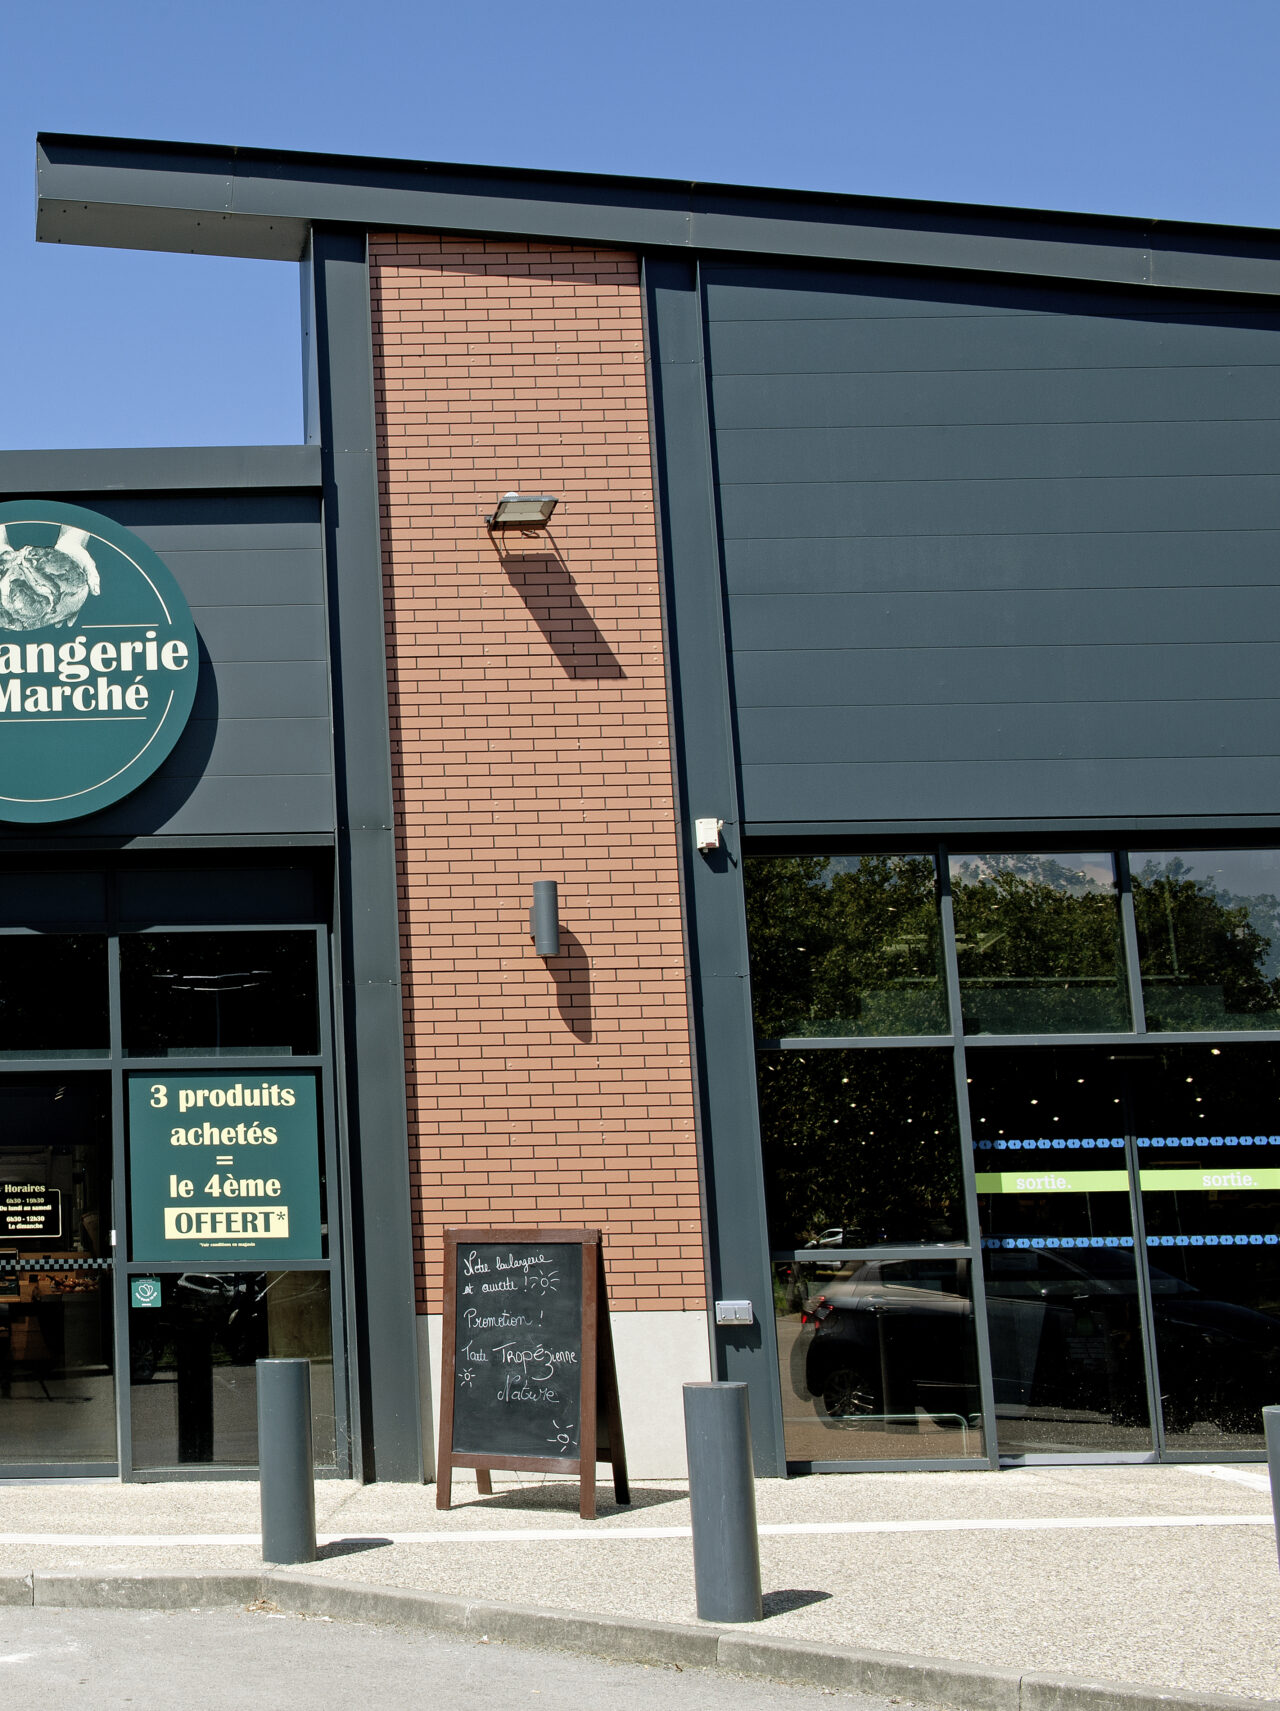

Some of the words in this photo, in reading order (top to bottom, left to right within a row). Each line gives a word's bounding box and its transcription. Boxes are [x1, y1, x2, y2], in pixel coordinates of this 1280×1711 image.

[150, 1084, 168, 1108] 3
[179, 1083, 296, 1112] produits
[170, 1121, 278, 1146] achetés
[4, 1184, 46, 1193] Horaires
[169, 1175, 194, 1198] le
[204, 1174, 281, 1197] 4ème
[1016, 1175, 1072, 1190] sortie.
[1202, 1171, 1258, 1187] sortie.
[464, 1308, 533, 1328] Promotion
